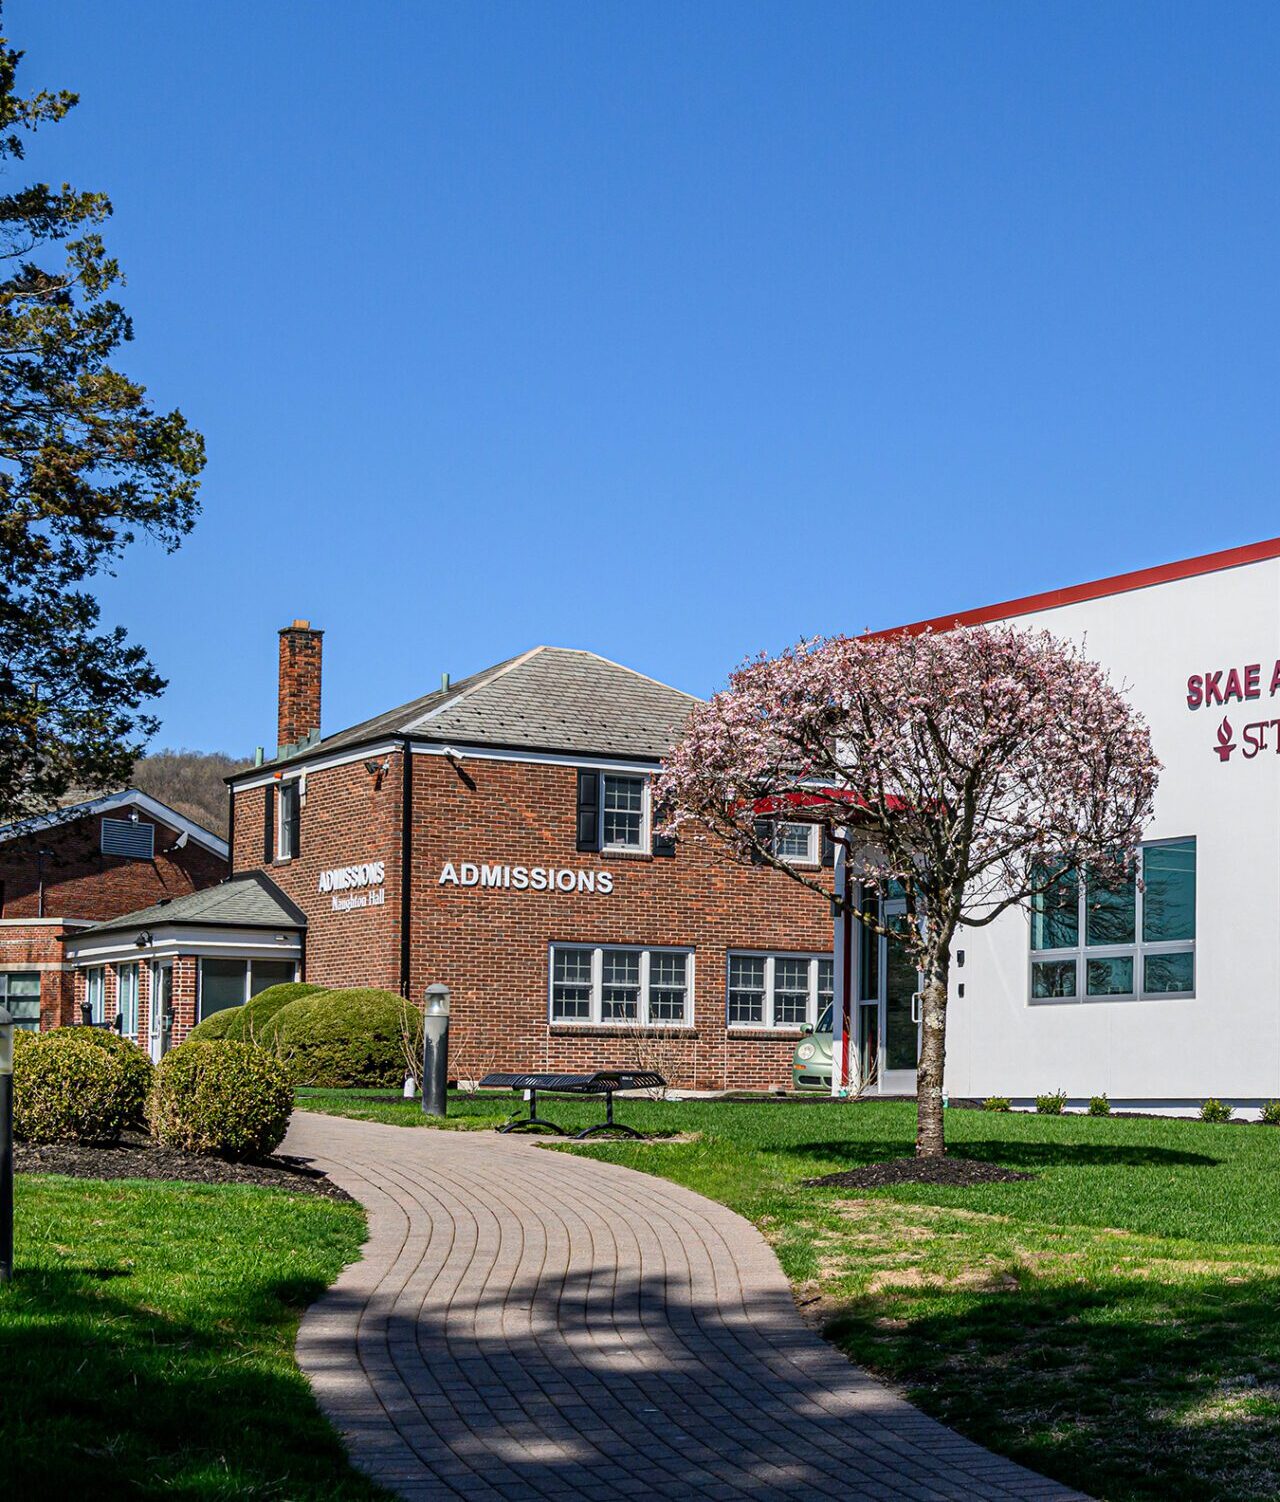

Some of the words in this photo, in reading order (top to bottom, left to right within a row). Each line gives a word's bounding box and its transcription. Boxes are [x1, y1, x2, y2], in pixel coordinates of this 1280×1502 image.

[1186, 664, 1261, 710] SKAE
[318, 861, 385, 893] ADMISSIONS
[438, 862, 614, 896] ADMISSIONS
[331, 893, 367, 912] Naughton
[368, 888, 385, 906] Hall
